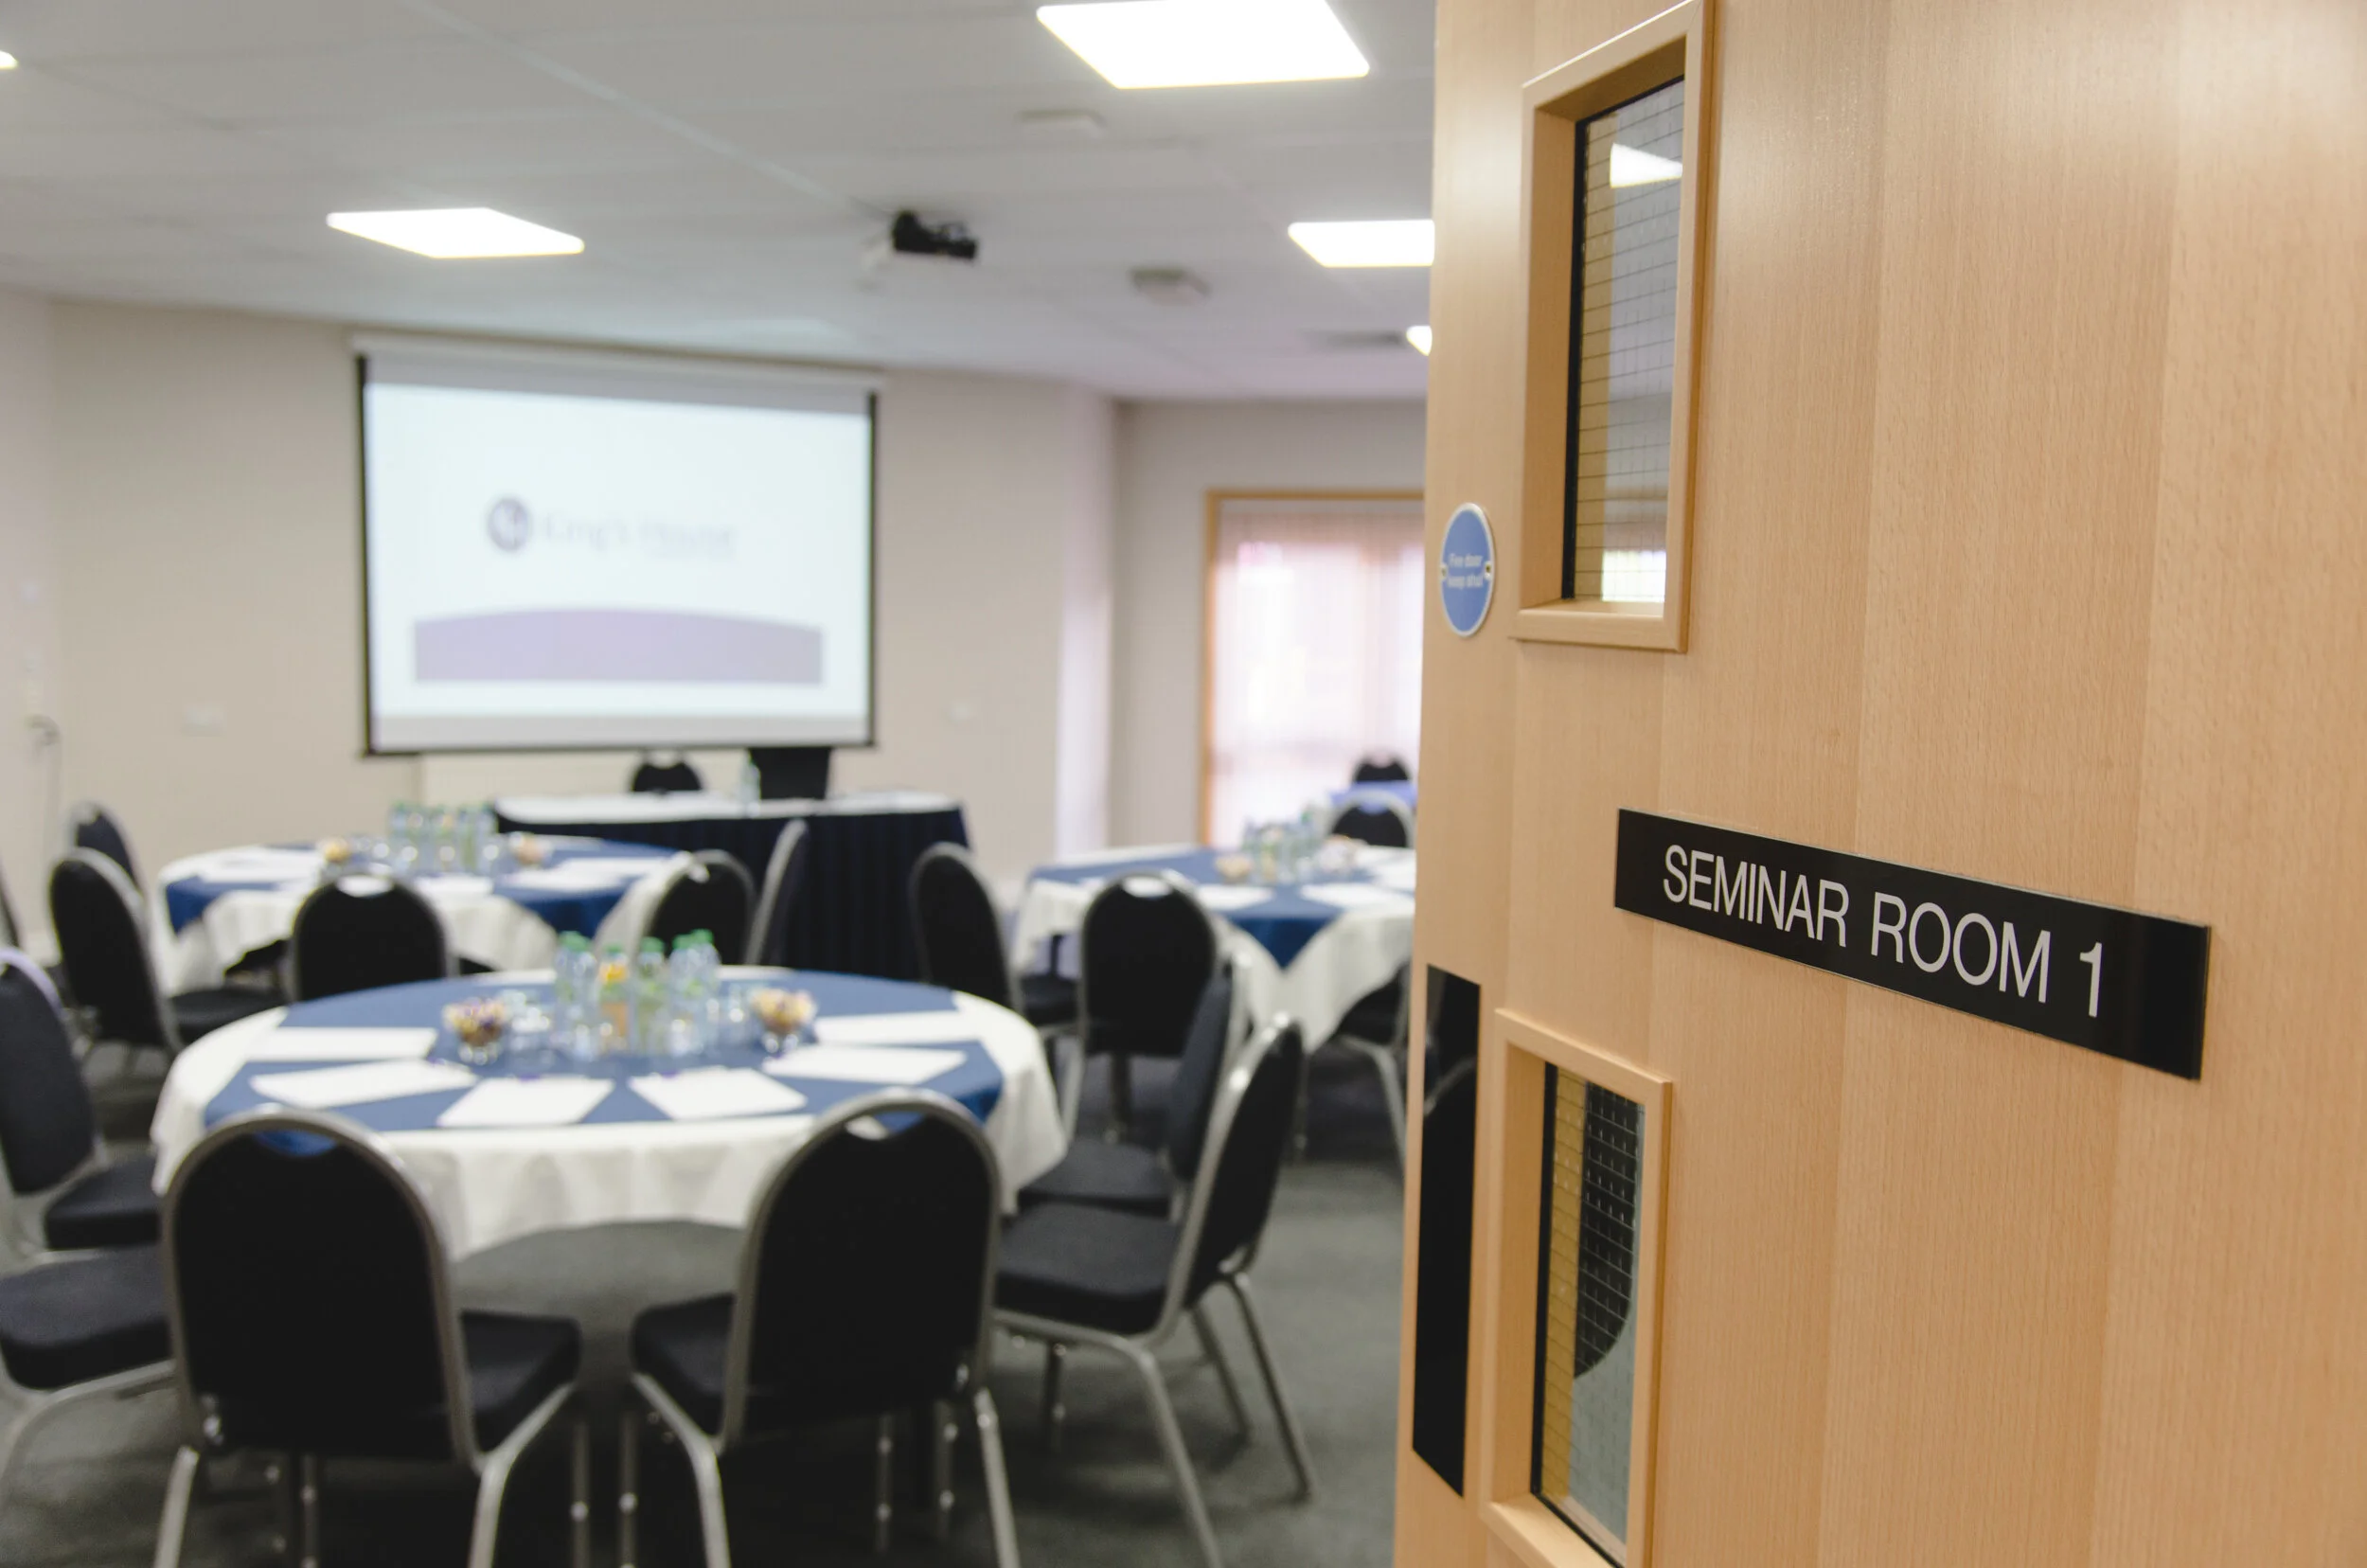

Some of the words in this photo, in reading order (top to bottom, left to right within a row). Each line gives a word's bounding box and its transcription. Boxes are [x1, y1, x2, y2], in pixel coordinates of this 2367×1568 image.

[1664, 845, 1849, 948] SEMINAR
[1871, 891, 2051, 1004] ROOM
[2079, 942, 2103, 1018] 1
